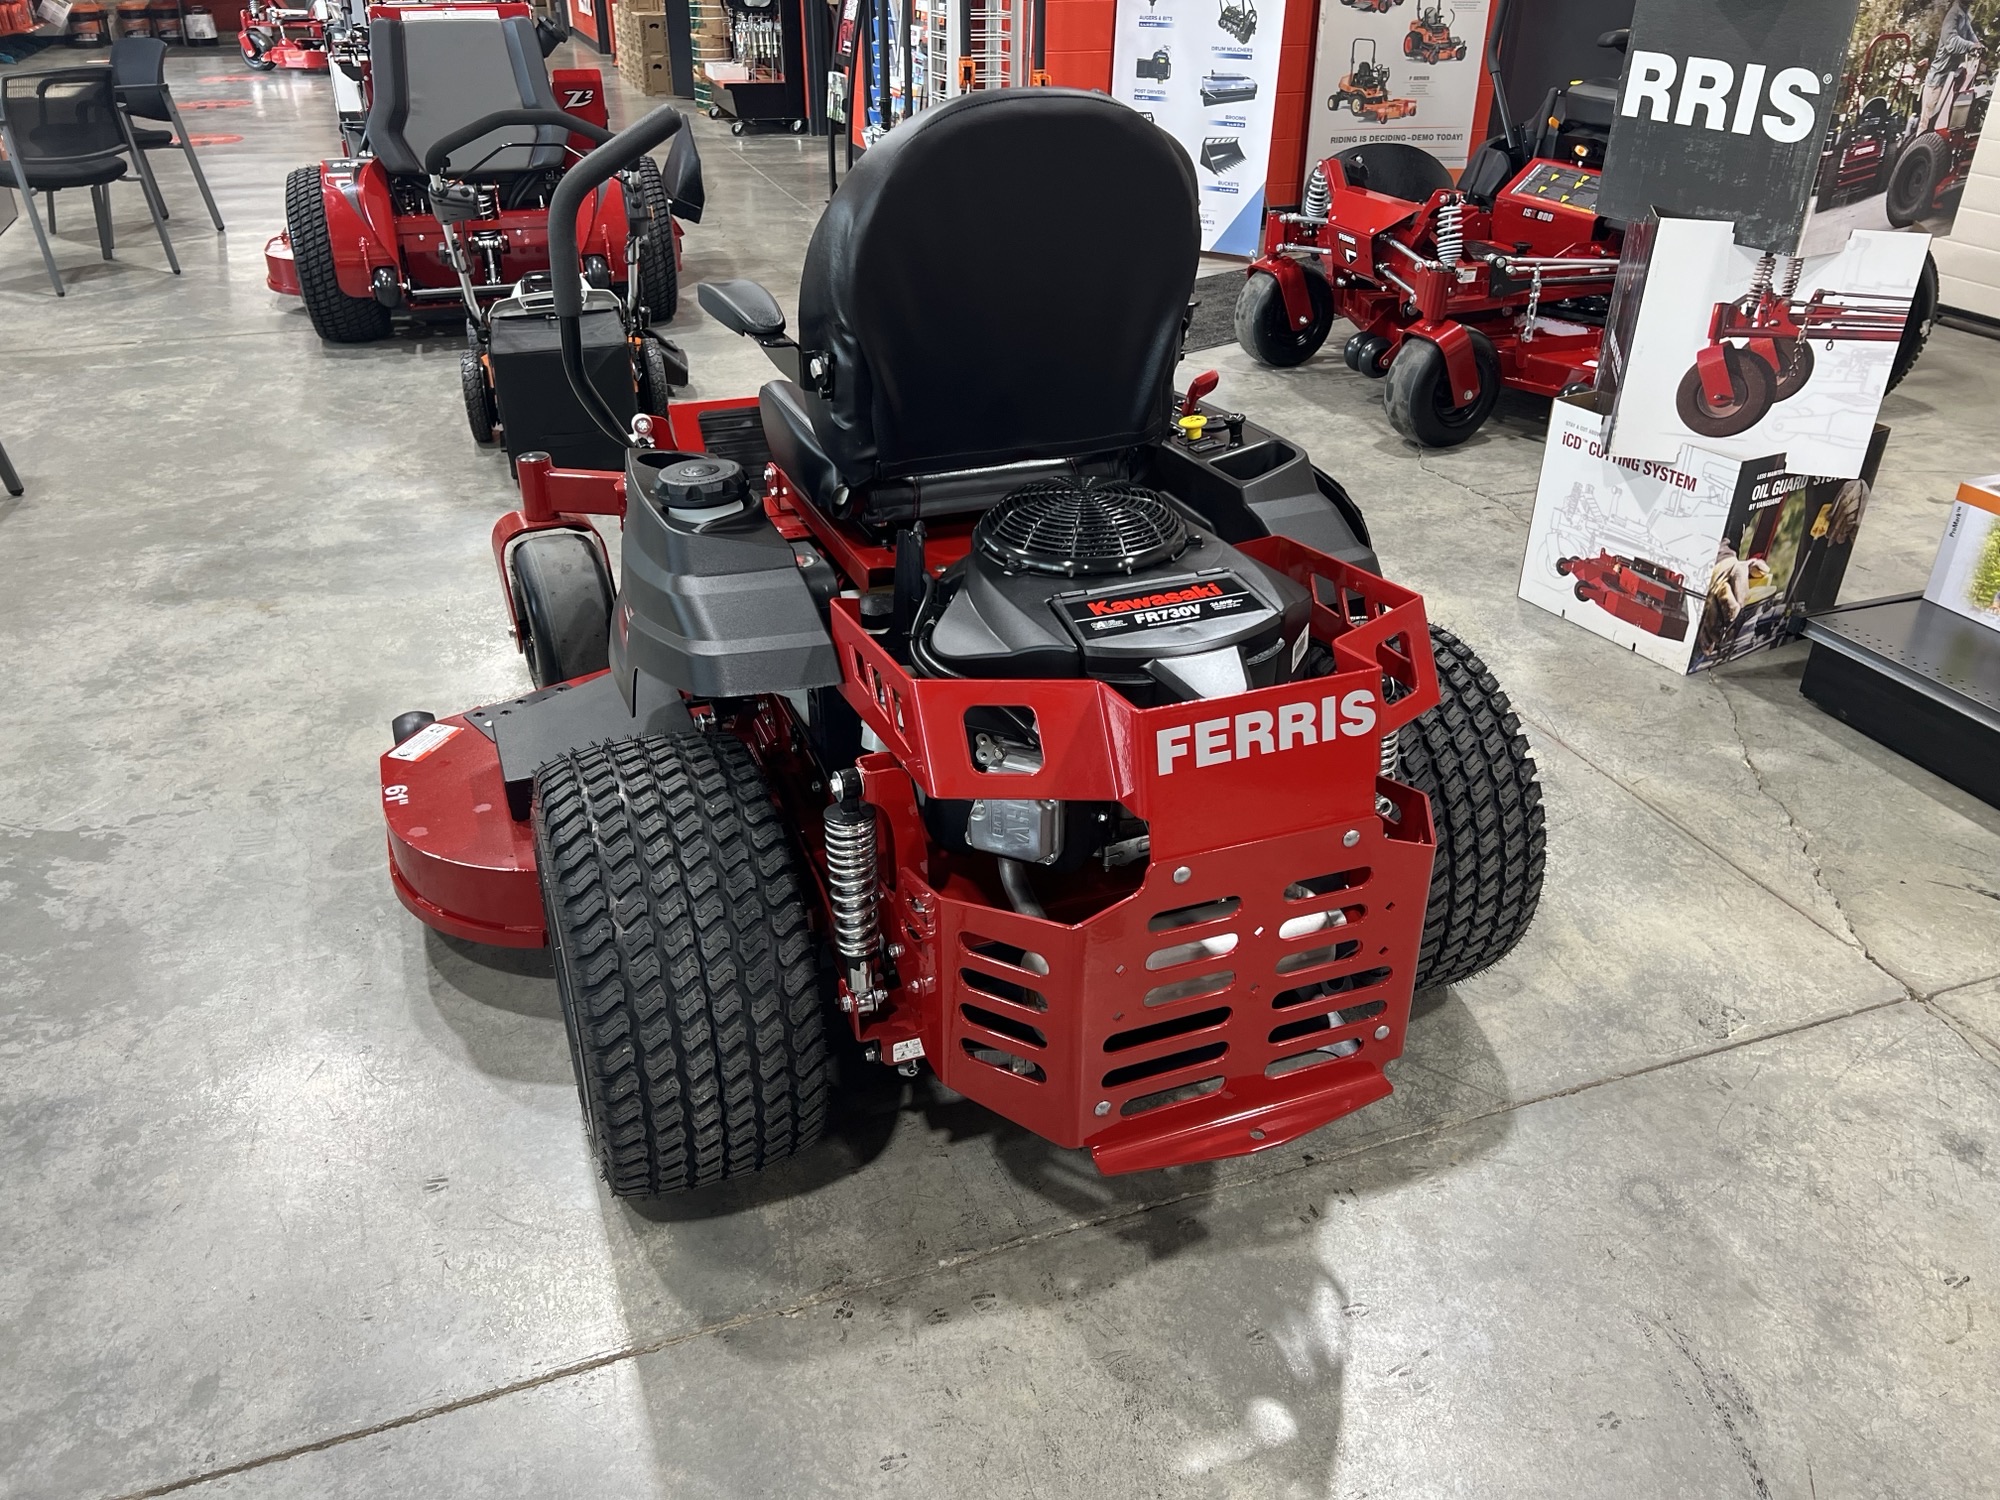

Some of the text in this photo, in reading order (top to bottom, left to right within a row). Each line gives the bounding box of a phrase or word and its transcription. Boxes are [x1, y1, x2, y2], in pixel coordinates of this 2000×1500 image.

[1330, 136, 1357, 144] RIDING
[1359, 135, 1367, 143] IS
[1436, 133, 1463, 141] TODAY!
[1643, 460, 1697, 492] SYSTEM
[1751, 482, 1769, 501] OIL
[1771, 475, 1809, 496] GUARD
[1087, 582, 1223, 617] Kawasaki
[1134, 603, 1202, 625] FR730V
[1156, 689, 1377, 777] FERRIS
